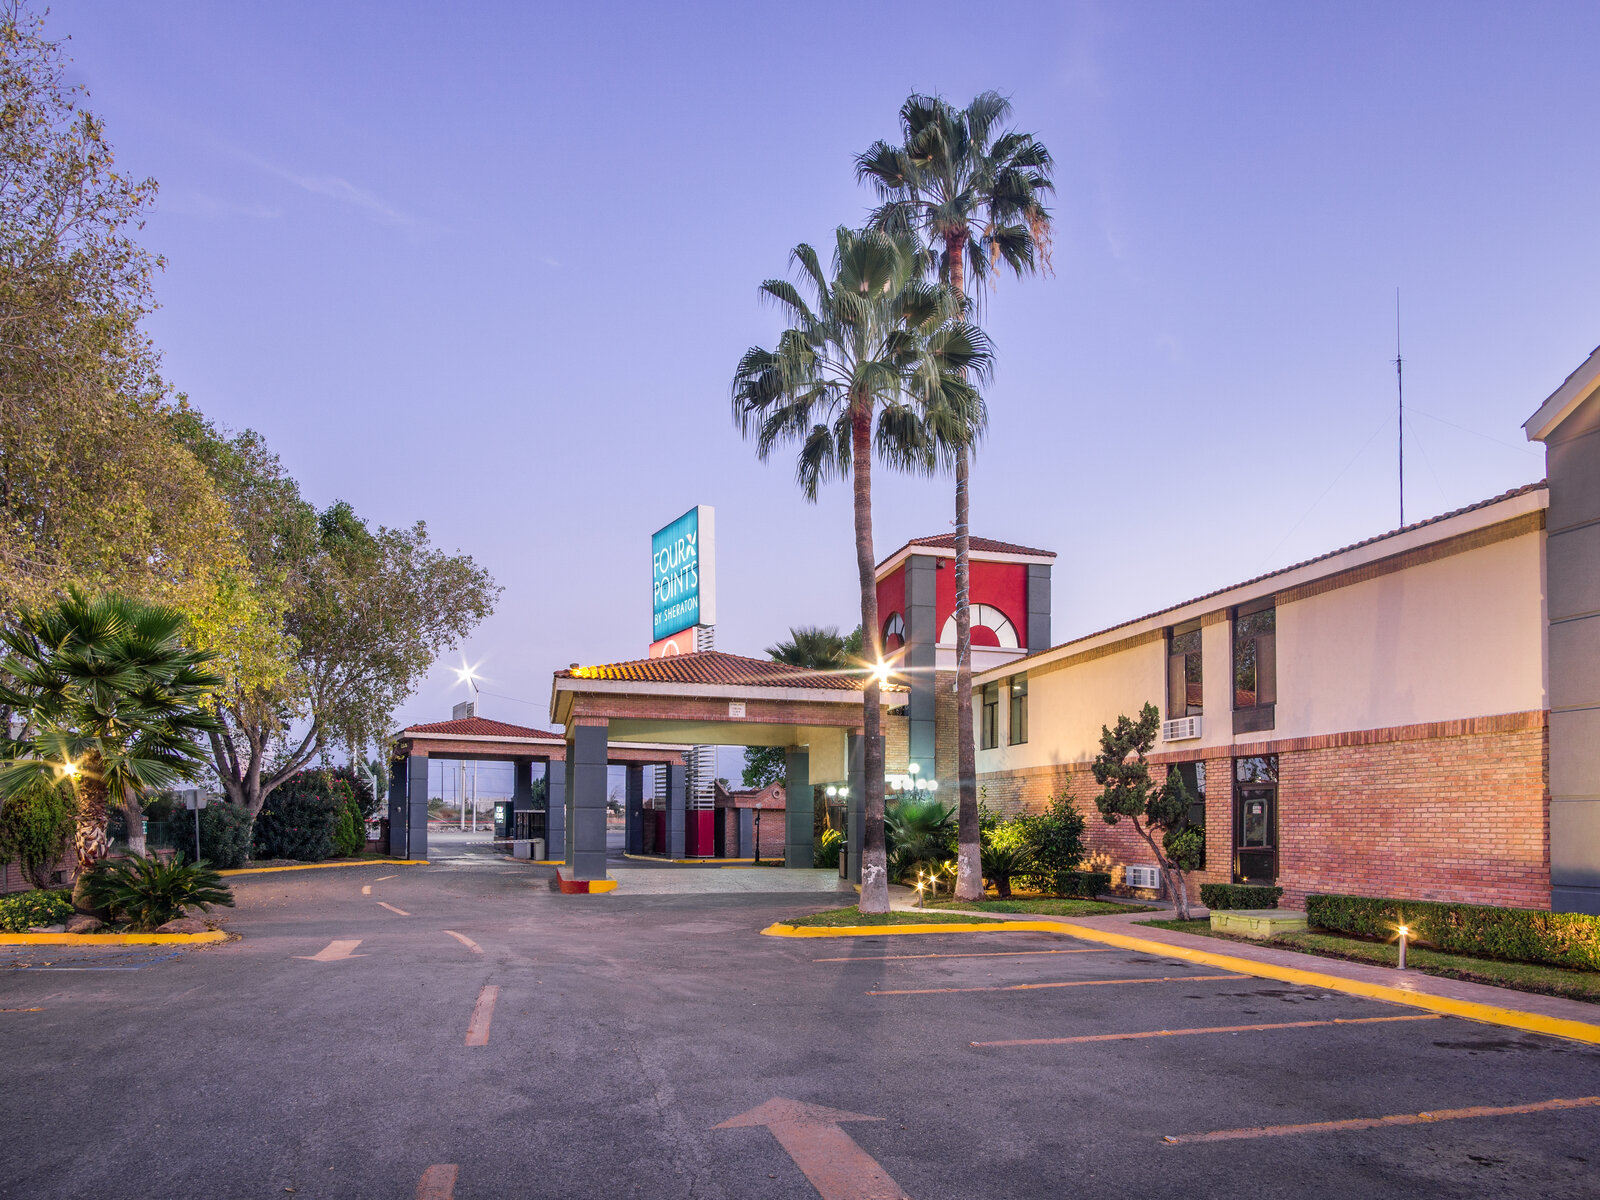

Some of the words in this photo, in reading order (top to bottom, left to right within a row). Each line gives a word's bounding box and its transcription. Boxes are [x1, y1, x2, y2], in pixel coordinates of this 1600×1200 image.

[653, 538, 687, 578] FOUR
[654, 560, 698, 605] POINTS
[654, 611, 662, 626] BY
[664, 595, 698, 622] SHERATON
